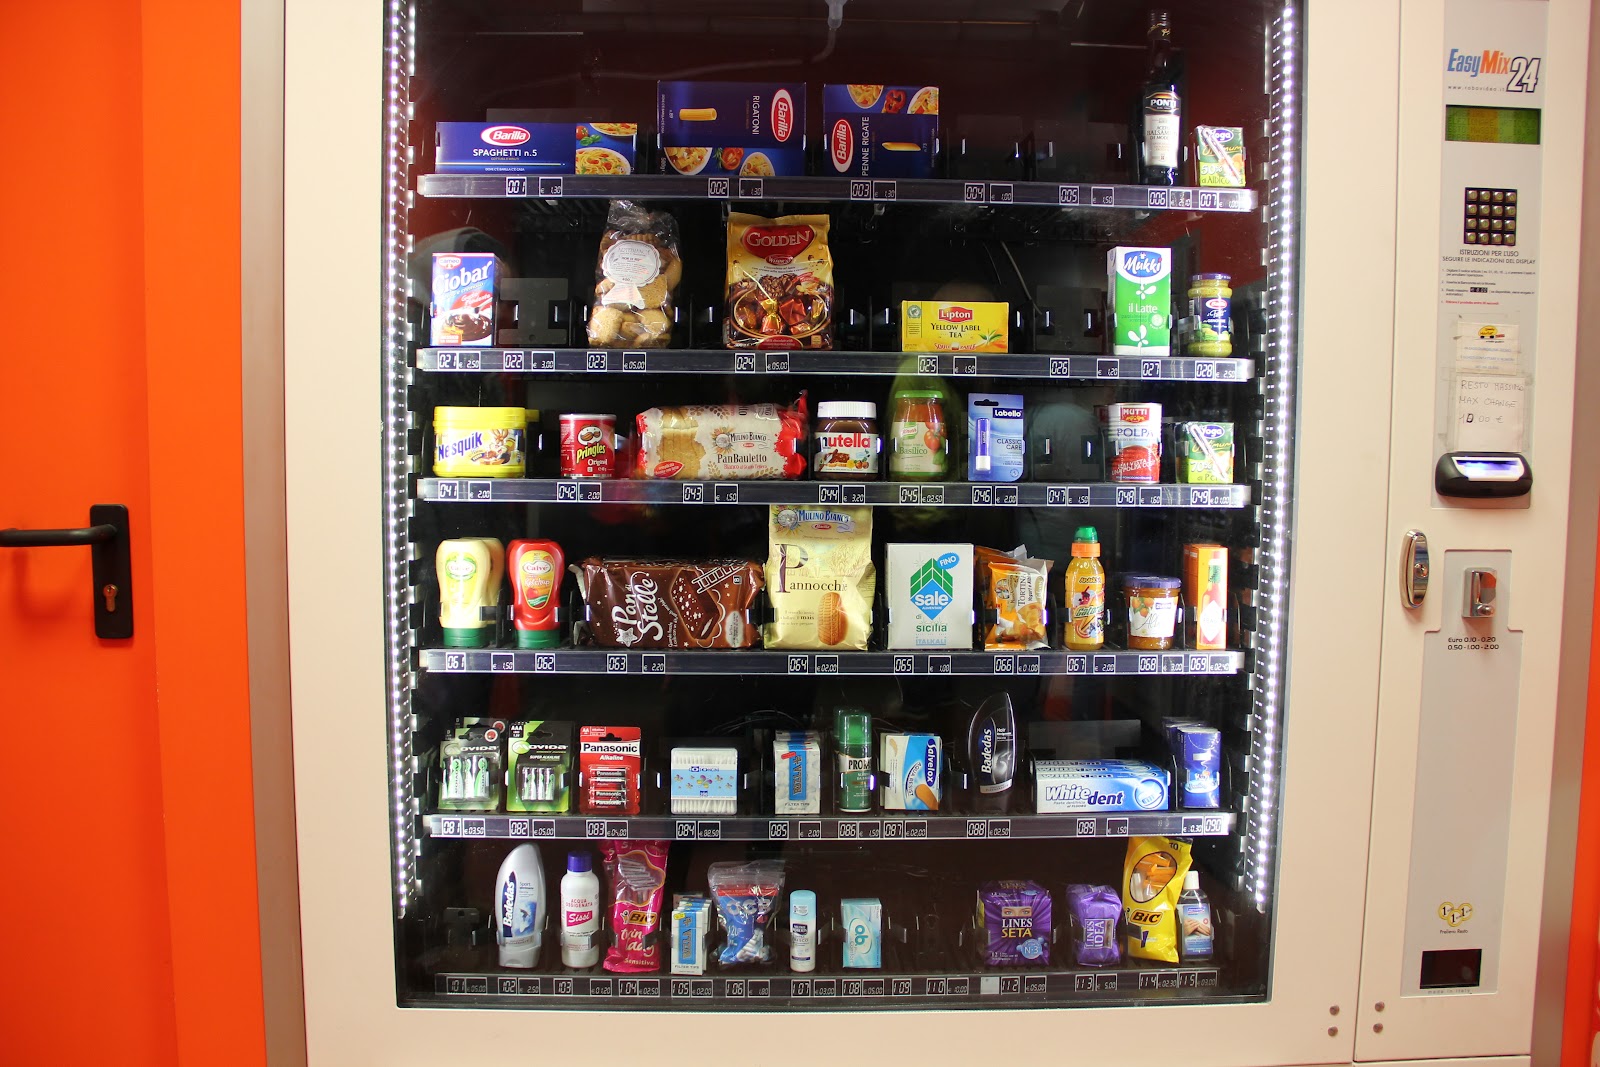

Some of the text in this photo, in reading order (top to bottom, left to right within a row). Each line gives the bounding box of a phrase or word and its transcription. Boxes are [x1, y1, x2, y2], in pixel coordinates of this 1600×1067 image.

[1447, 48, 1541, 93] EasyMix 24
[752, 95, 760, 135] RIGATONI
[778, 97, 789, 138] Barilla
[493, 130, 527, 140] Barilla
[837, 124, 847, 161] Barilla
[861, 116, 870, 176] PENNE RIGATE
[473, 149, 538, 157] SPAGHETTI n.5
[508, 180, 526, 194] 001
[710, 181, 728, 195] 002
[852, 183, 870, 197] 003
[966, 187, 984, 200] 004
[1060, 189, 1078, 202] 005
[1201, 194, 1217, 207] 007
[747, 230, 811, 247] GOLDEN
[1123, 255, 1162, 274] Mukki
[433, 261, 493, 296] Ciobar
[1128, 303, 1158, 313] il Latte
[941, 310, 971, 320] Lipton
[931, 323, 959, 331] YELLOW
[439, 354, 457, 369] 021
[505, 354, 523, 369] 022
[588, 354, 606, 369] 023
[736, 357, 754, 370] 024
[920, 359, 937, 372] 025
[1051, 360, 1068, 375] 026
[1143, 362, 1160, 376] 027
[1196, 364, 1213, 378] 028
[1461, 380, 1489, 390] RESTO
[1458, 396, 1518, 409] MAX CHANGE
[994, 409, 1022, 417] Labello
[438, 432, 482, 461] Nesquik
[822, 433, 871, 448] nutella
[576, 443, 606, 464] Pringles
[899, 446, 928, 455] Basilico
[717, 453, 767, 463] PanBauletto
[440, 484, 458, 497] 041
[559, 485, 576, 499] 042
[684, 487, 702, 500] 043
[820, 488, 839, 501] 044
[901, 489, 918, 502] 045
[974, 490, 990, 503] 046
[1048, 490, 1065, 503] 047
[1118, 490, 1135, 503] 048
[799, 510, 849, 522] MULINO BIANCO
[940, 555, 957, 566] FINO
[915, 591, 949, 606] sale
[612, 594, 637, 625] Pan
[634, 578, 663, 641] Stelle
[916, 623, 947, 632] sicilia
[448, 656, 465, 669] 061
[537, 657, 553, 669] 062
[609, 657, 626, 671] 063
[789, 658, 807, 671] 064
[895, 658, 912, 671] 065
[996, 658, 1012, 671] 066
[1068, 658, 1085, 671] 067
[1140, 658, 1156, 671] 068
[583, 743, 638, 753] Panasonic
[981, 728, 992, 774] Badedas
[927, 739, 936, 782] Salvelox
[443, 821, 460, 834] 081
[511, 821, 527, 834] 082
[587, 823, 605, 836] 083
[770, 824, 787, 836] 085
[840, 824, 857, 836] 086
[885, 824, 902, 837] 087
[968, 823, 985, 836] 088
[1078, 822, 1094, 834] 089
[503, 881, 515, 927] Badedas
[568, 913, 590, 923] Sissi
[1002, 918, 1033, 928] LINES
[1002, 928, 1032, 938] SETA
[1086, 921, 1094, 948] LINES
[1095, 921, 1104, 948] IDEA
[624, 957, 655, 966] Sensitive
[502, 981, 516, 993] 102
[558, 982, 571, 994] 103
[620, 982, 636, 993] 104
[672, 982, 689, 994] 105
[843, 982, 860, 994] 108
[1002, 979, 1018, 992] 112
[1076, 976, 1092, 989] 113
